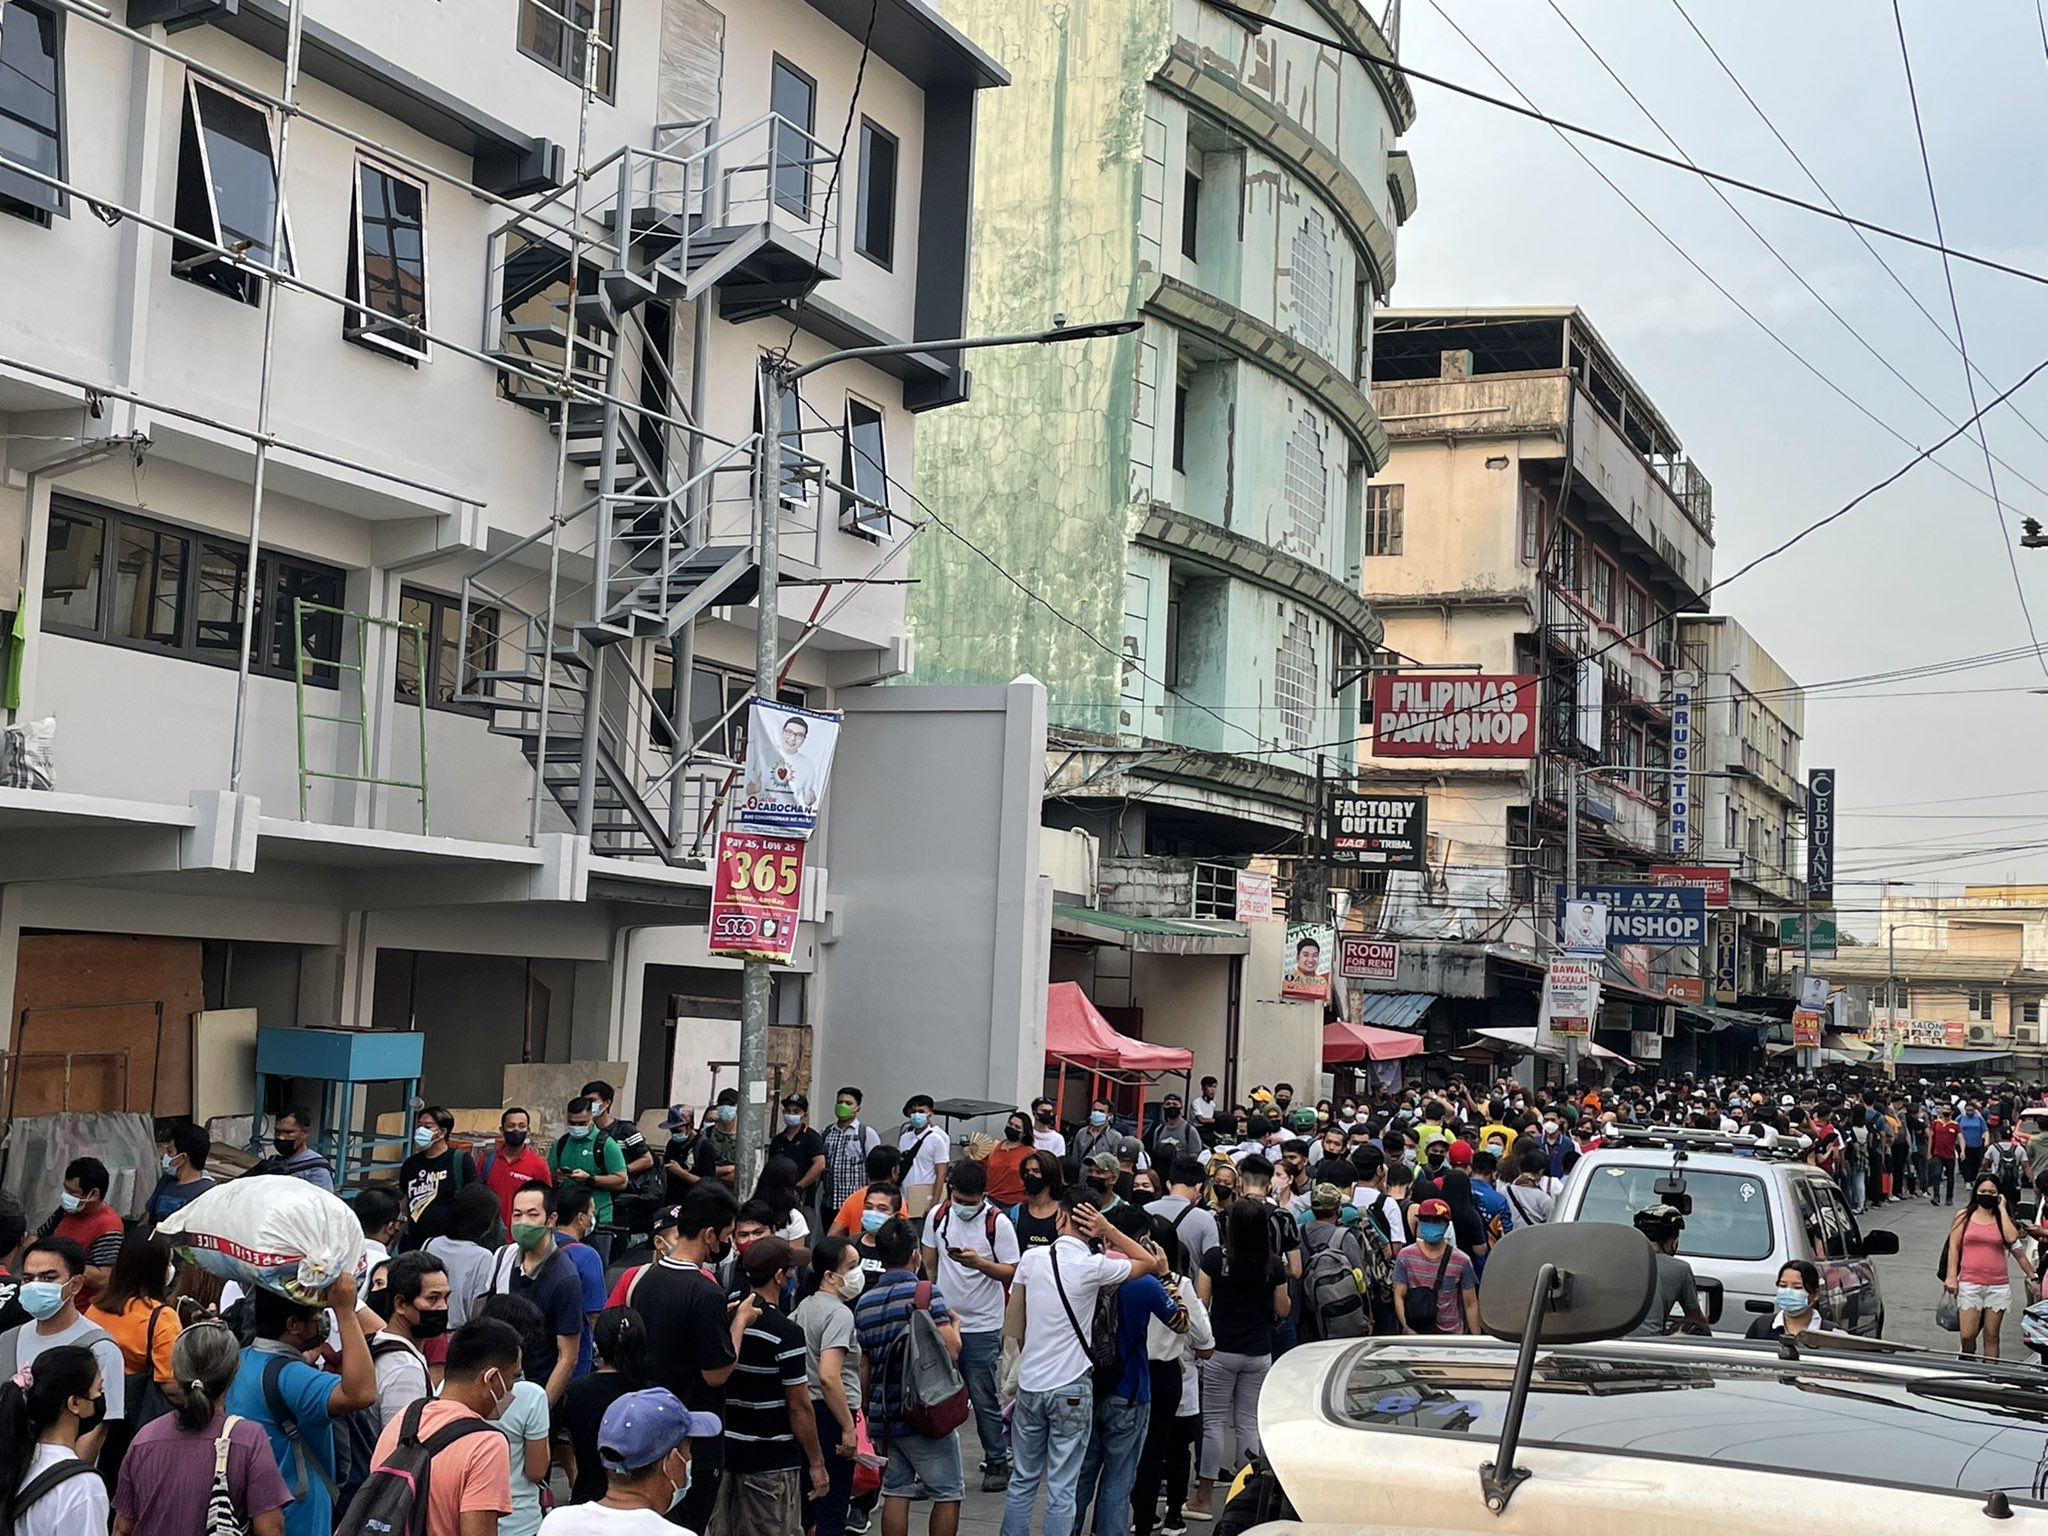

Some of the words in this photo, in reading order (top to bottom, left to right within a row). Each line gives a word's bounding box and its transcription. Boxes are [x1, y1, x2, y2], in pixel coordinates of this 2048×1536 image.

[1392, 681, 1517, 712] FILIPINAS
[1380, 712, 1528, 750] PAWNSHOP
[1672, 693, 1689, 851] DRUGSTORE
[758, 802, 812, 814] CABOCHAN
[1334, 800, 1415, 817] FACTORY
[1341, 817, 1407, 834] OUTLET
[1811, 774, 1831, 891] CEBUANA
[725, 837, 742, 848] Pay
[763, 840, 781, 850] Low
[784, 843, 796, 851] as
[1379, 839, 1412, 849] TRIBAL
[714, 914, 758, 935] SOGO
[1288, 926, 1327, 944] MAYOR
[1347, 943, 1393, 959] ROOM
[1718, 922, 1735, 990] BOTICA
[1346, 957, 1366, 966] FOR
[1368, 959, 1394, 968] RENT
[1552, 965, 1586, 974] BAWAL
[1667, 984, 1685, 996] ria
[1911, 1022, 1943, 1030] SALON
